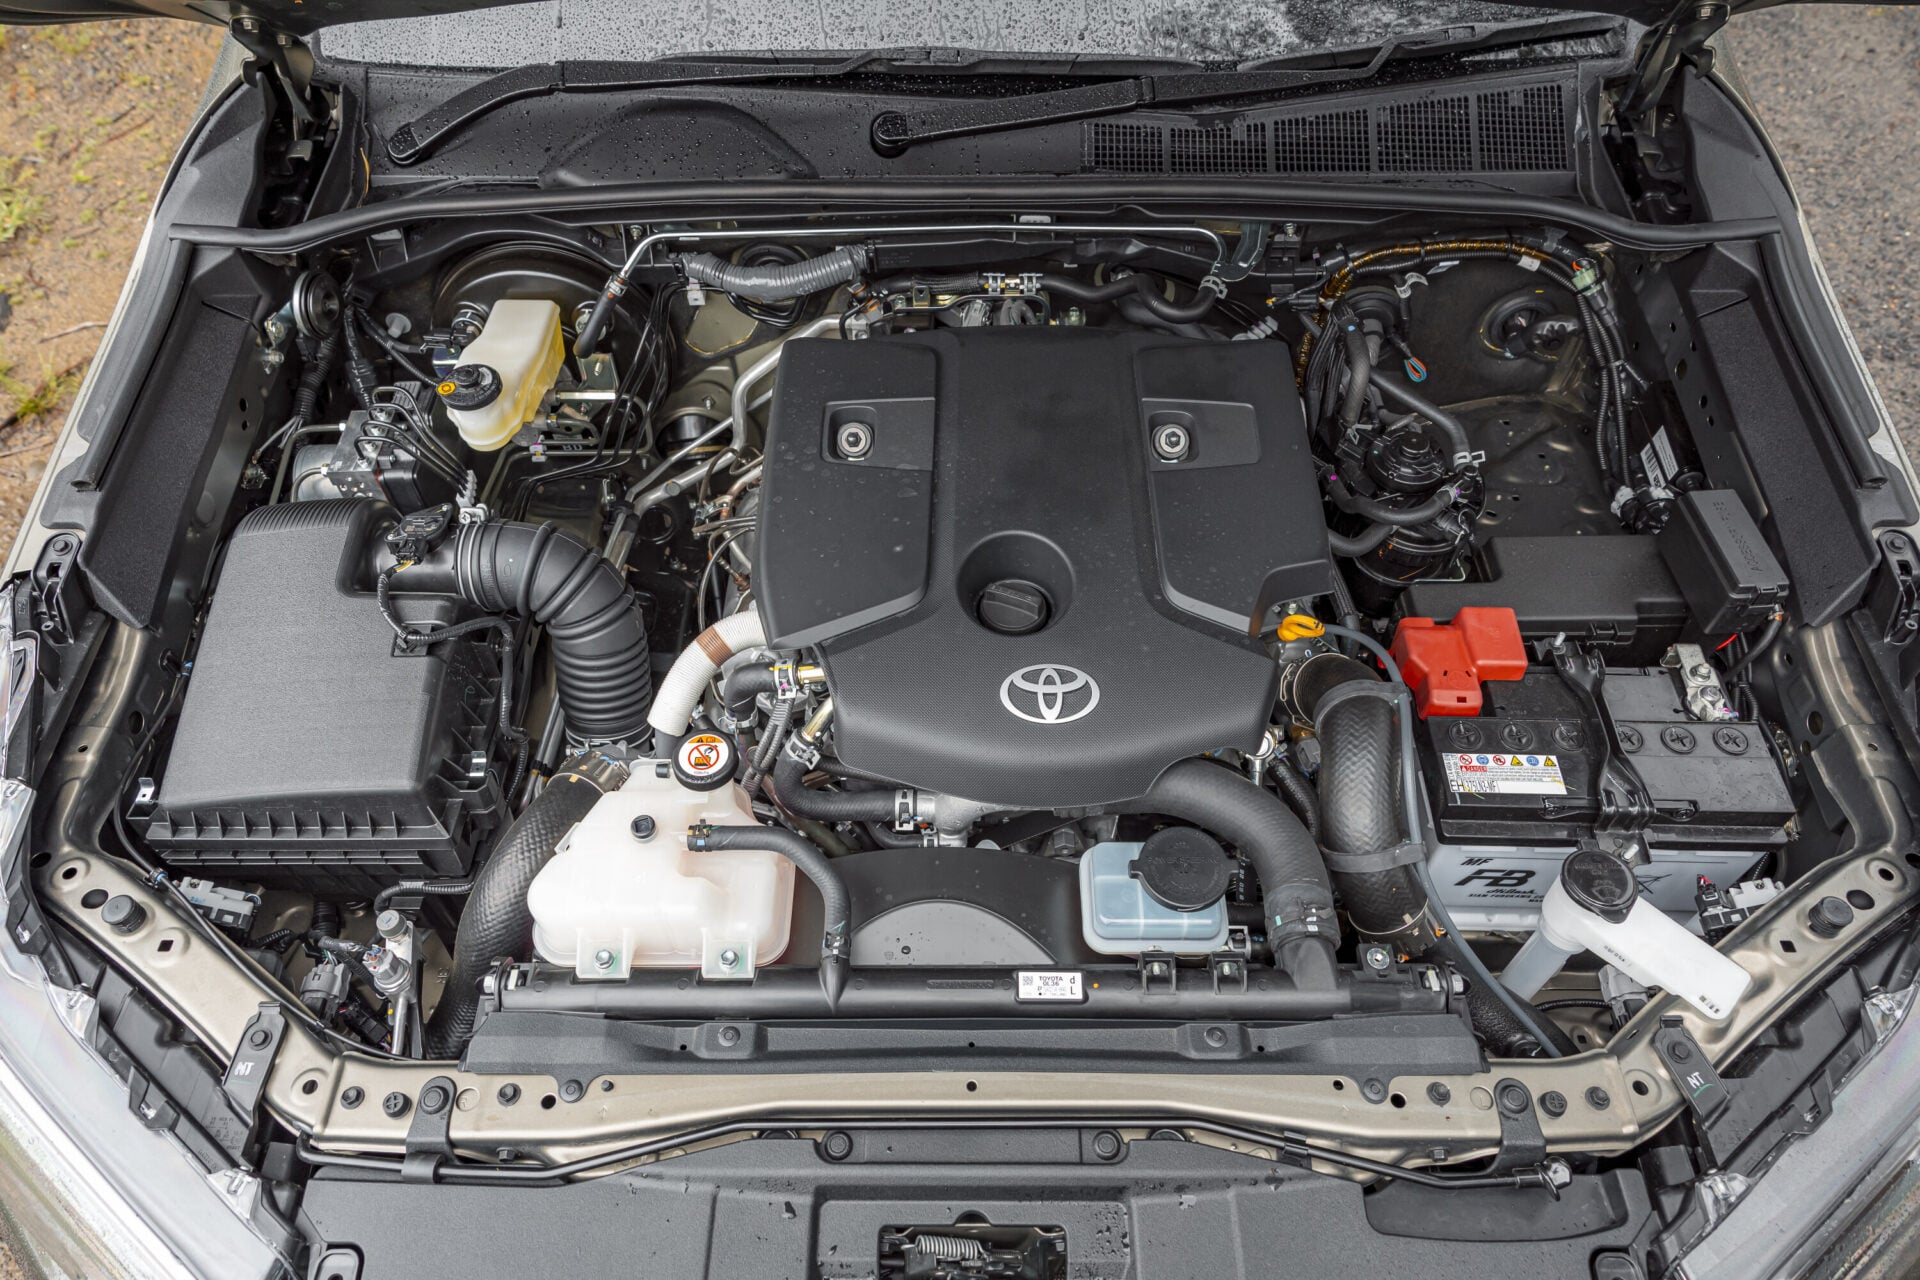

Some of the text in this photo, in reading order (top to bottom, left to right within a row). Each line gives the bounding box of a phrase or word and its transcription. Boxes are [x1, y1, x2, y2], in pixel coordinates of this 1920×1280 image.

[1460, 858, 1494, 866] MF
[1454, 869, 1536, 887] FB
[234, 1062, 255, 1076] NT
[1686, 1071, 1704, 1089] NT
